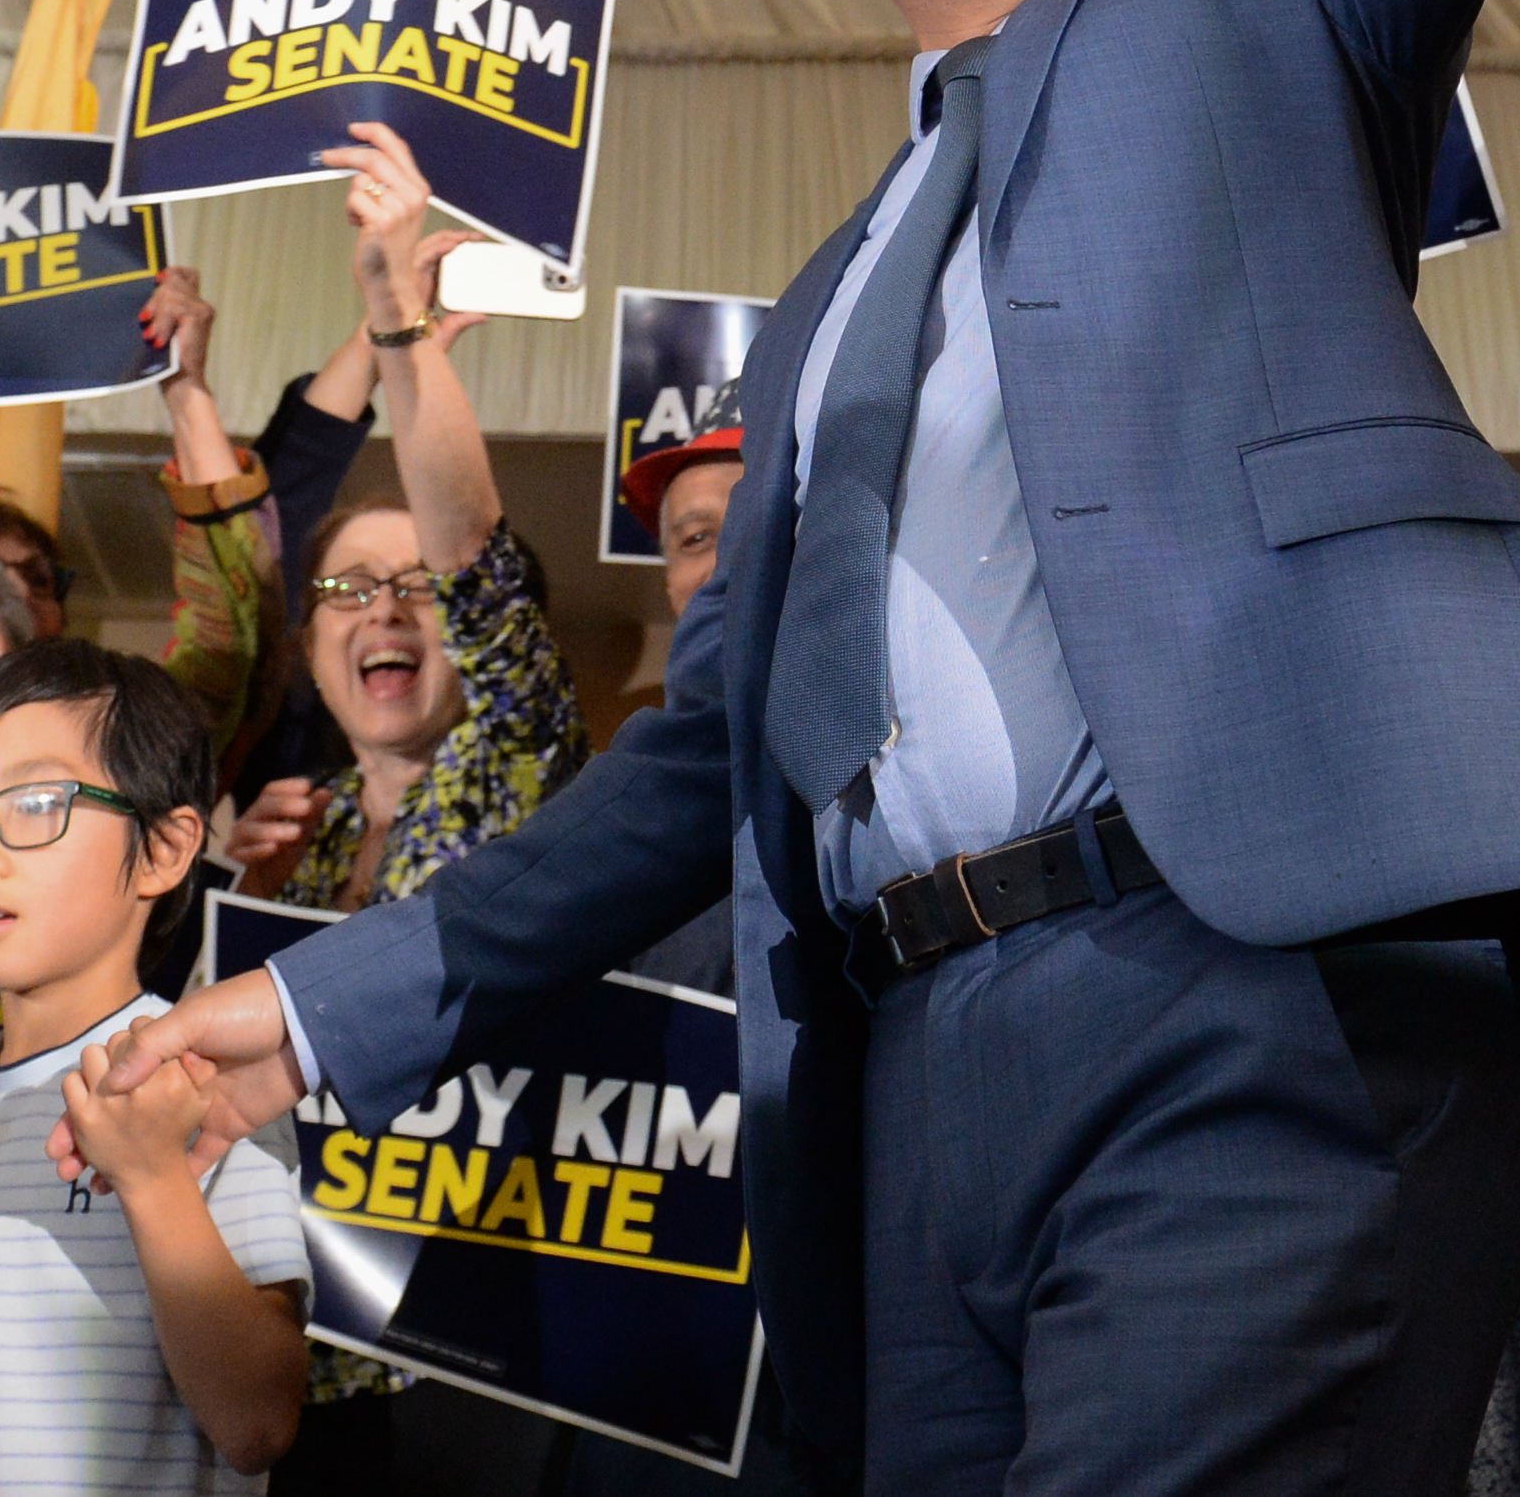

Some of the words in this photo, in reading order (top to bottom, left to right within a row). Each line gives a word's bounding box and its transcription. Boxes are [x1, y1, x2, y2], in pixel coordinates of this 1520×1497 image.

[224, 22, 521, 115] SENATE
[551, 1073, 740, 1179] KIM
[312, 1128, 663, 1254] SENATE
